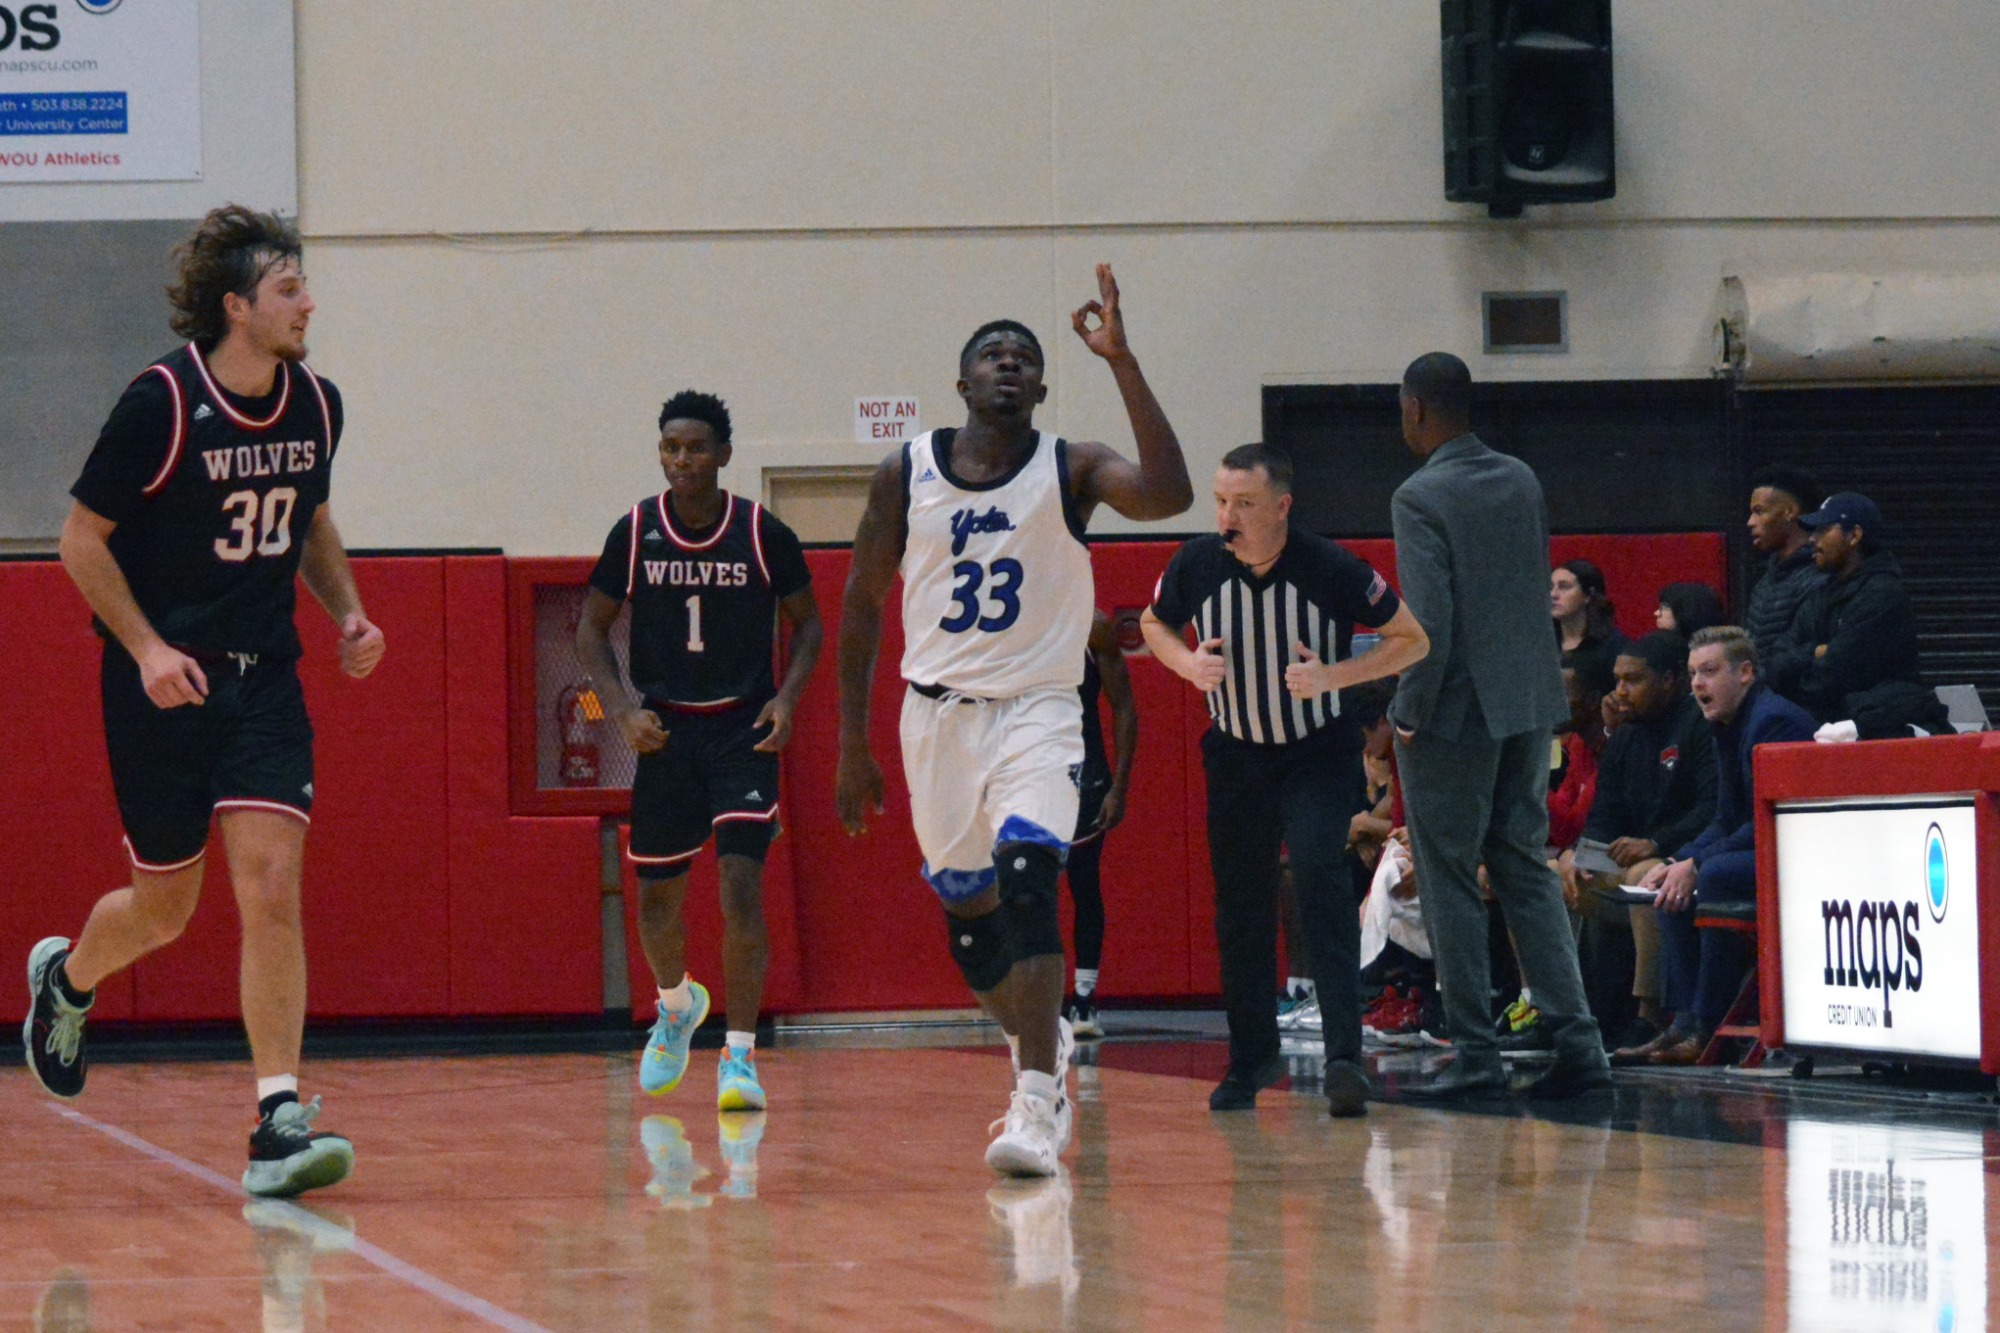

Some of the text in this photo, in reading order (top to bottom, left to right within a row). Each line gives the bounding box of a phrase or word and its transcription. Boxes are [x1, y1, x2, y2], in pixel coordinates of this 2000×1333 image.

[6, 119, 74, 132] University
[78, 118, 123, 130] Center
[45, 151, 121, 166] Athletics
[860, 401, 916, 417] NOT AN
[872, 422, 905, 438] EXIT
[202, 440, 316, 481] WOLVES
[213, 486, 297, 562] 30
[644, 560, 748, 586] WOLVES
[939, 557, 1024, 633] 33
[686, 595, 704, 652] 1
[1821, 899, 1923, 1028] maps
[1827, 1004, 1877, 1027] CREDIT UNION
